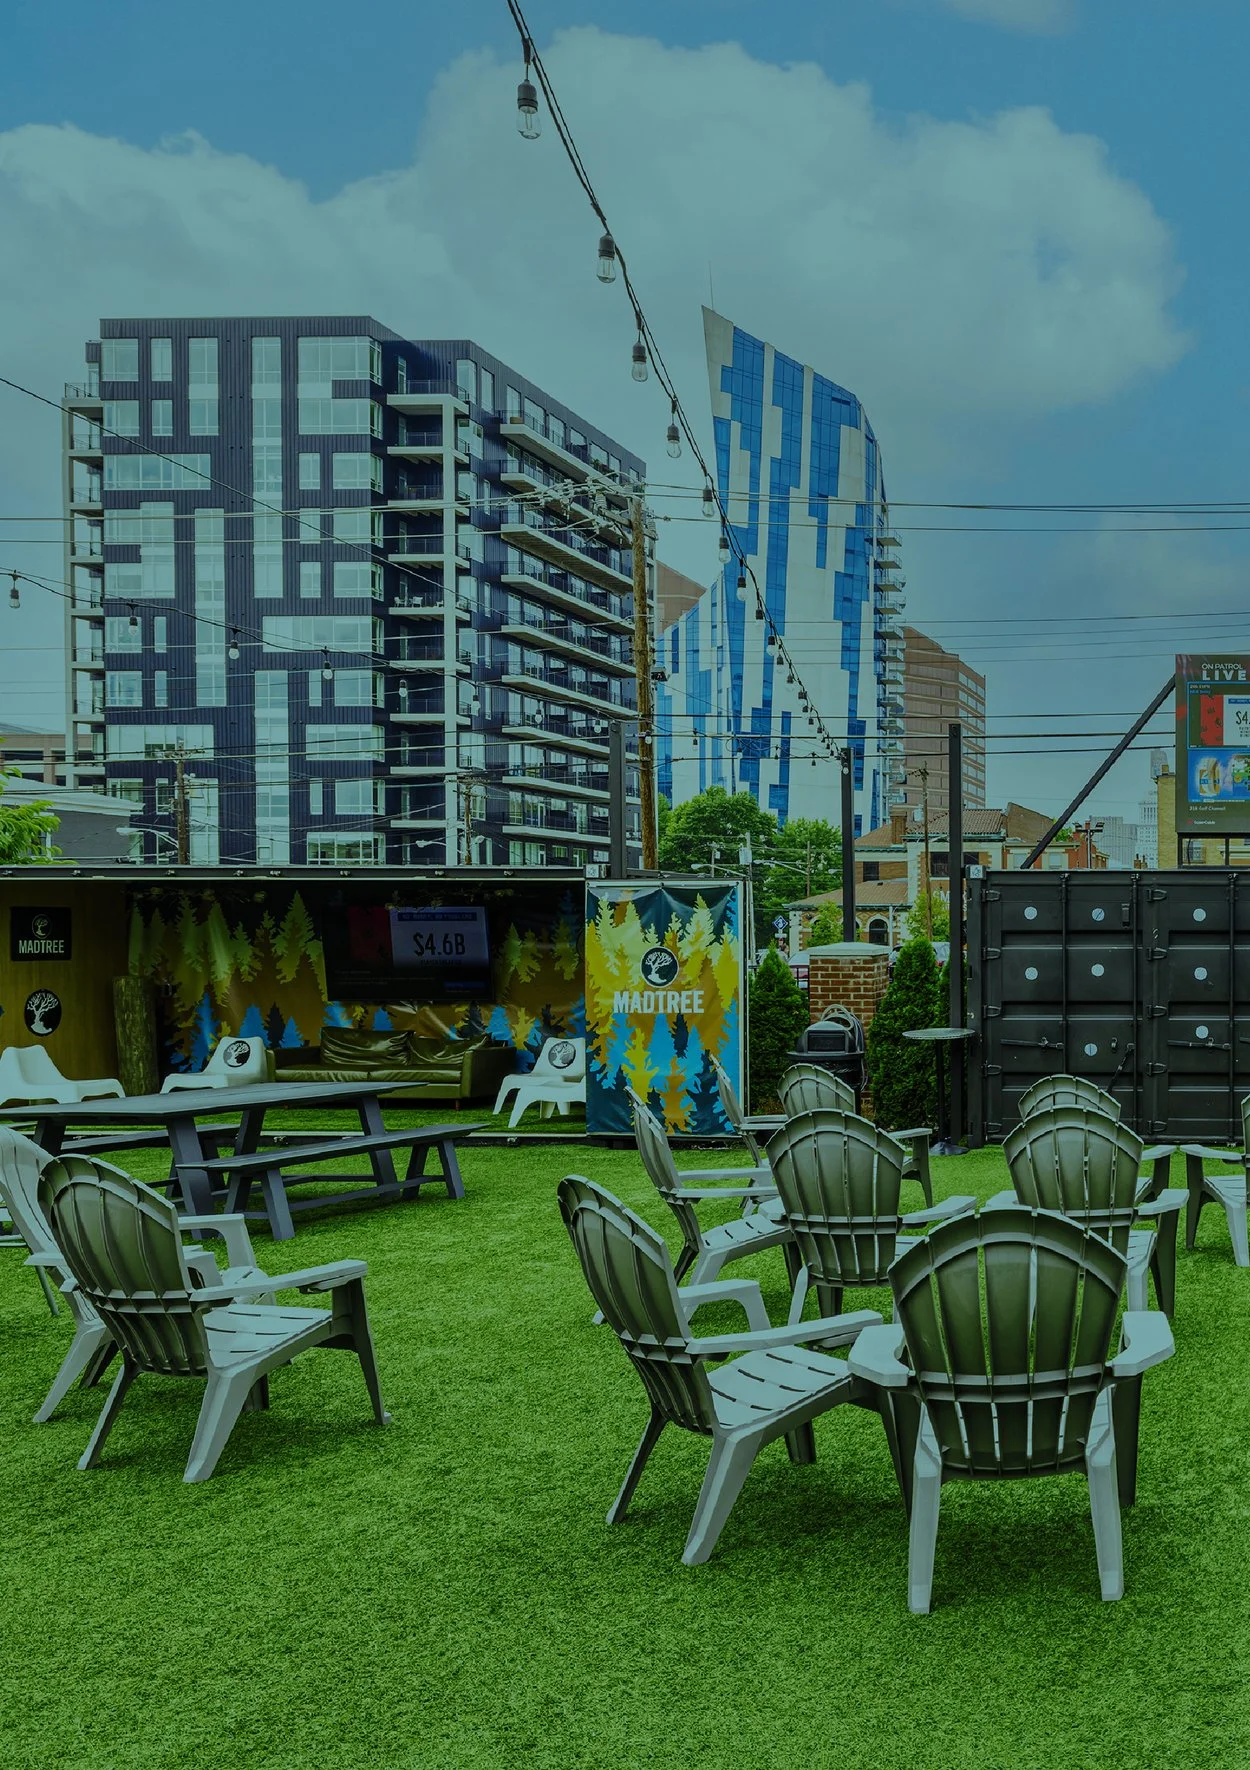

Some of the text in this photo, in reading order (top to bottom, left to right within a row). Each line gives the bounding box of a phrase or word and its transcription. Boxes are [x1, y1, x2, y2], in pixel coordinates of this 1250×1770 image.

[1202, 670, 1247, 681] LIVE
[18, 939, 65, 954] MADTREE
[413, 932, 466, 957] $4.6B
[613, 990, 705, 1014] MADTREE
